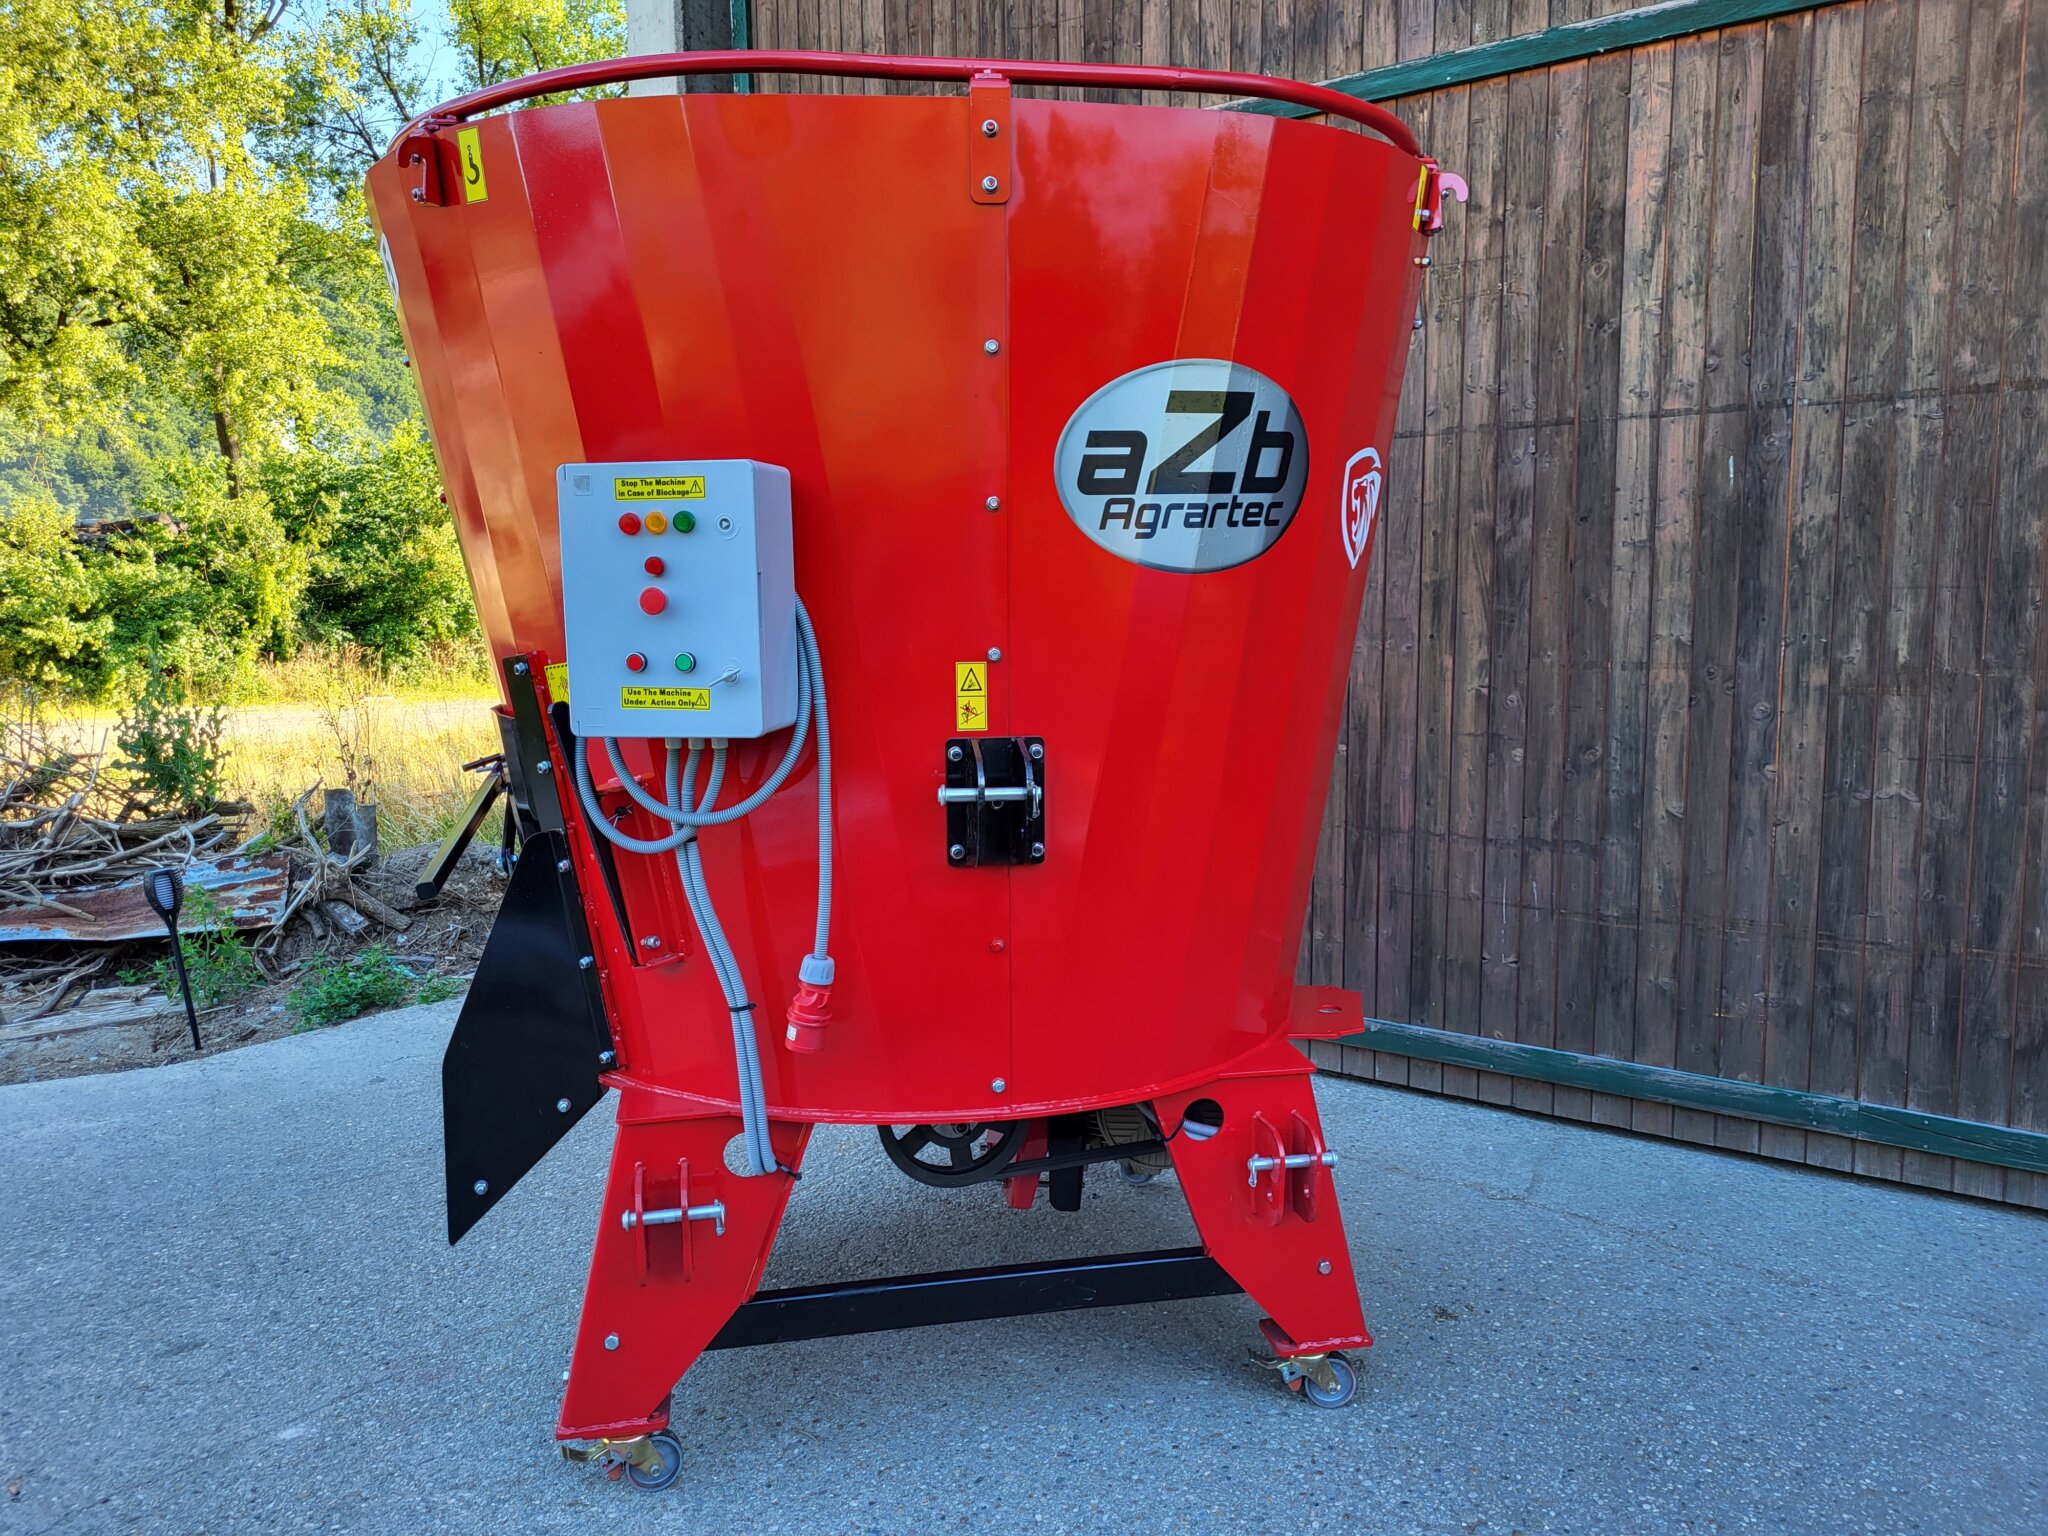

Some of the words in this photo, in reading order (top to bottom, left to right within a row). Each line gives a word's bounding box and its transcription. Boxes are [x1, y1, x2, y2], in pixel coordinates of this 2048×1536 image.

[621, 479, 638, 488] Stop
[640, 479, 653, 487] The
[655, 478, 686, 486] Machine
[618, 489, 625, 497] in
[627, 489, 645, 497] Case
[647, 488, 654, 496] of
[656, 488, 690, 497] Blockage
[1099, 495, 1284, 540] Agrartec
[627, 688, 642, 696] Use
[644, 688, 657, 696] The
[660, 688, 692, 697] Machine
[623, 698, 646, 706] Under
[651, 698, 676, 706] Action
[678, 698, 696, 708] Only
